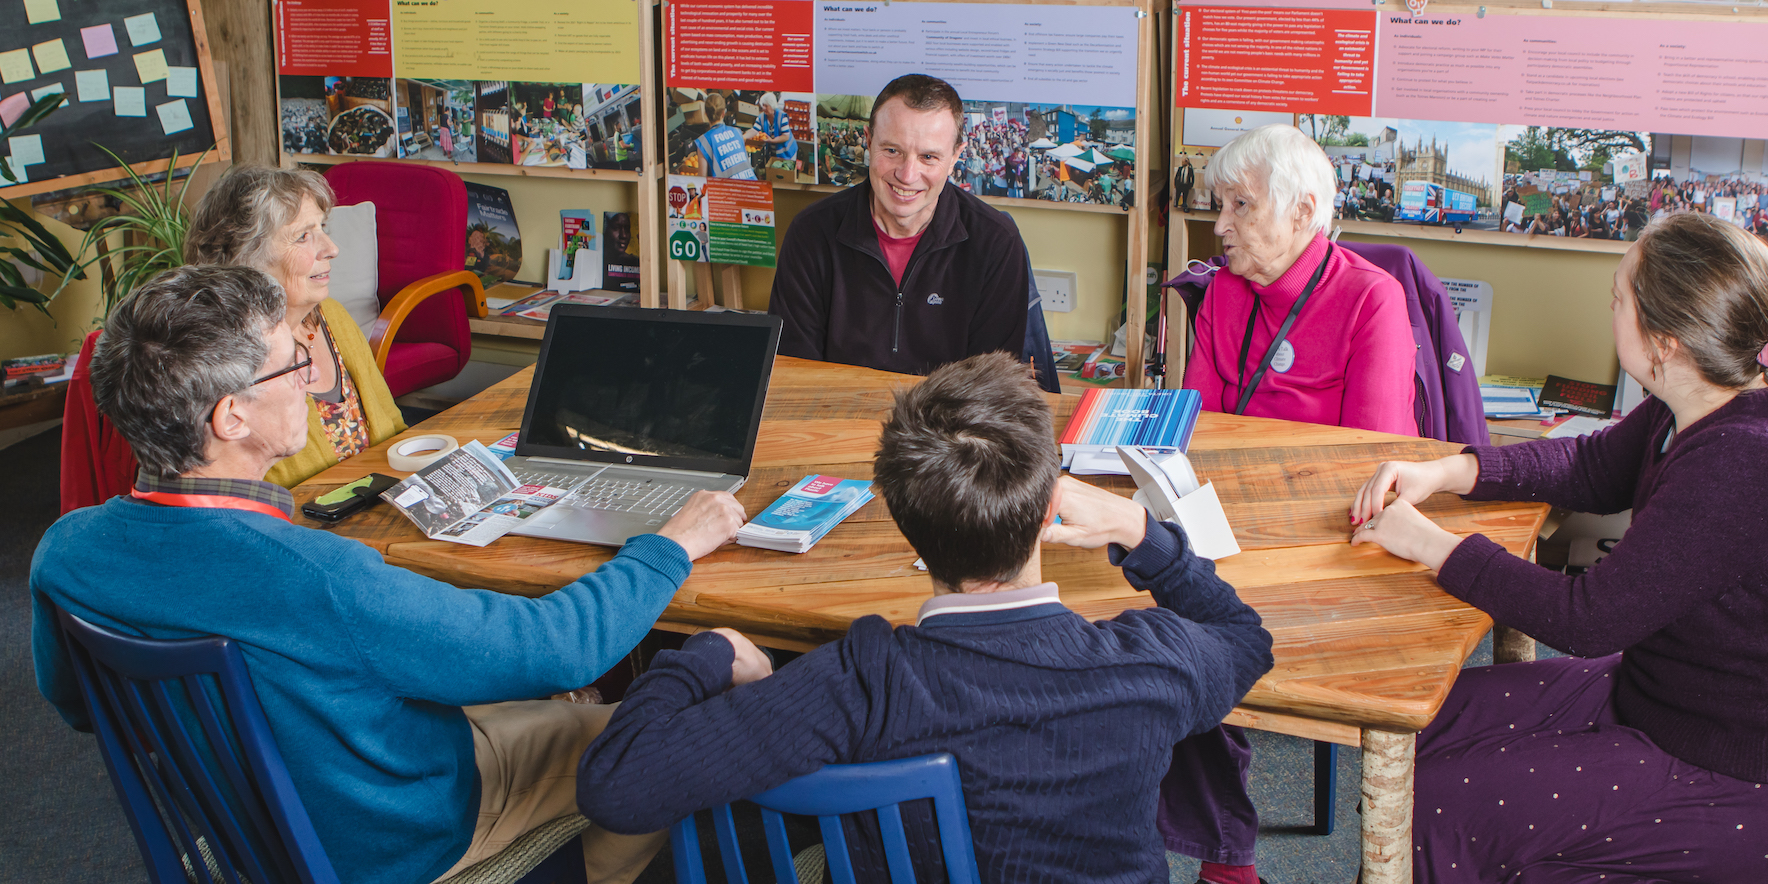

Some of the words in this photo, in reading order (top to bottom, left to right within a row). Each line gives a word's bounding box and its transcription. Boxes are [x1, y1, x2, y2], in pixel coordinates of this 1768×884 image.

[714, 130, 735, 143] FOOD
[717, 140, 742, 156] FACTS
[669, 192, 686, 202] STOP
[476, 203, 508, 216] Fairtrade
[479, 210, 506, 221] Matters
[672, 240, 696, 258] GO
[608, 264, 623, 272] LIVING
[624, 265, 640, 273] INCOM
[1556, 382, 1607, 395] FUNDING
[1561, 388, 1597, 399] FOSSIL
